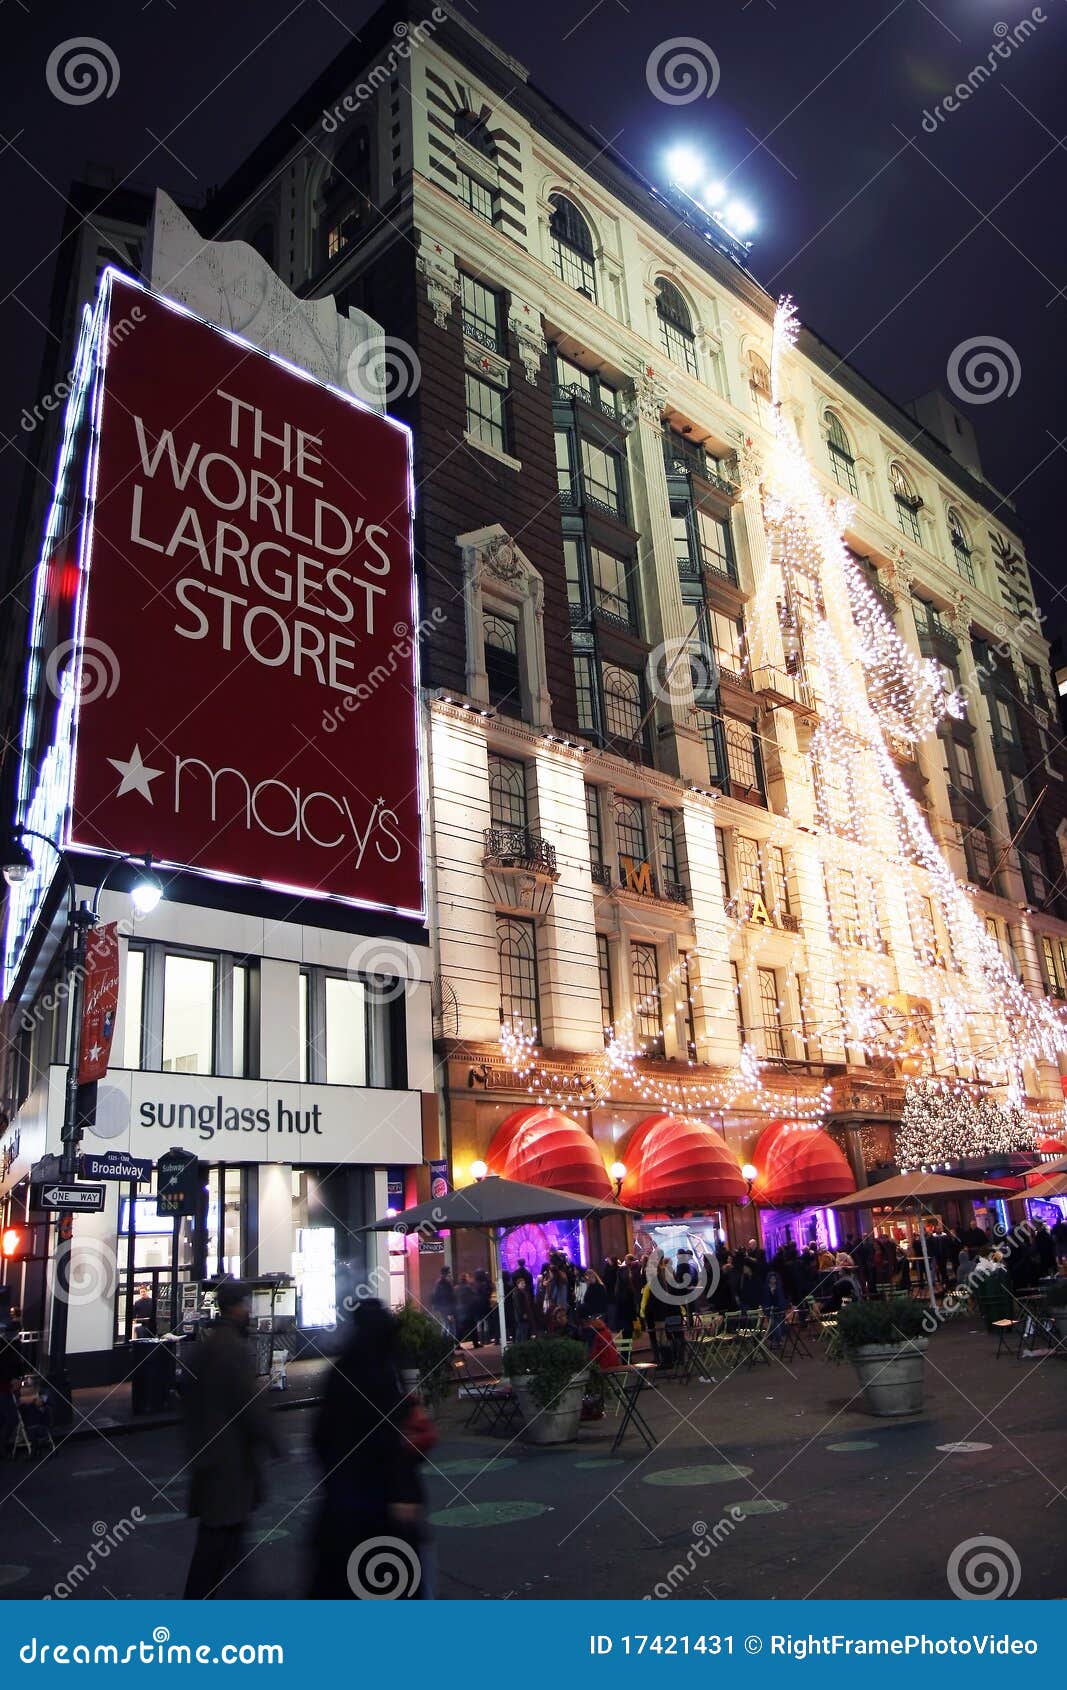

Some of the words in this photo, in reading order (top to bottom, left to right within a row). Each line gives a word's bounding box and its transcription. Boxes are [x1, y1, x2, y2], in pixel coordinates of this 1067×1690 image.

[217, 388, 323, 487] THE
[133, 415, 392, 576] WORLD'S
[131, 486, 386, 635] LARGEST
[174, 578, 357, 694] STORE
[174, 755, 401, 869] macy's
[92, 1161, 143, 1179] Broadway
[140, 1096, 270, 1139] sunglass
[277, 1100, 322, 1134] hut
[52, 1192, 70, 1201] ONE
[80, 1193, 98, 1202] WAY
